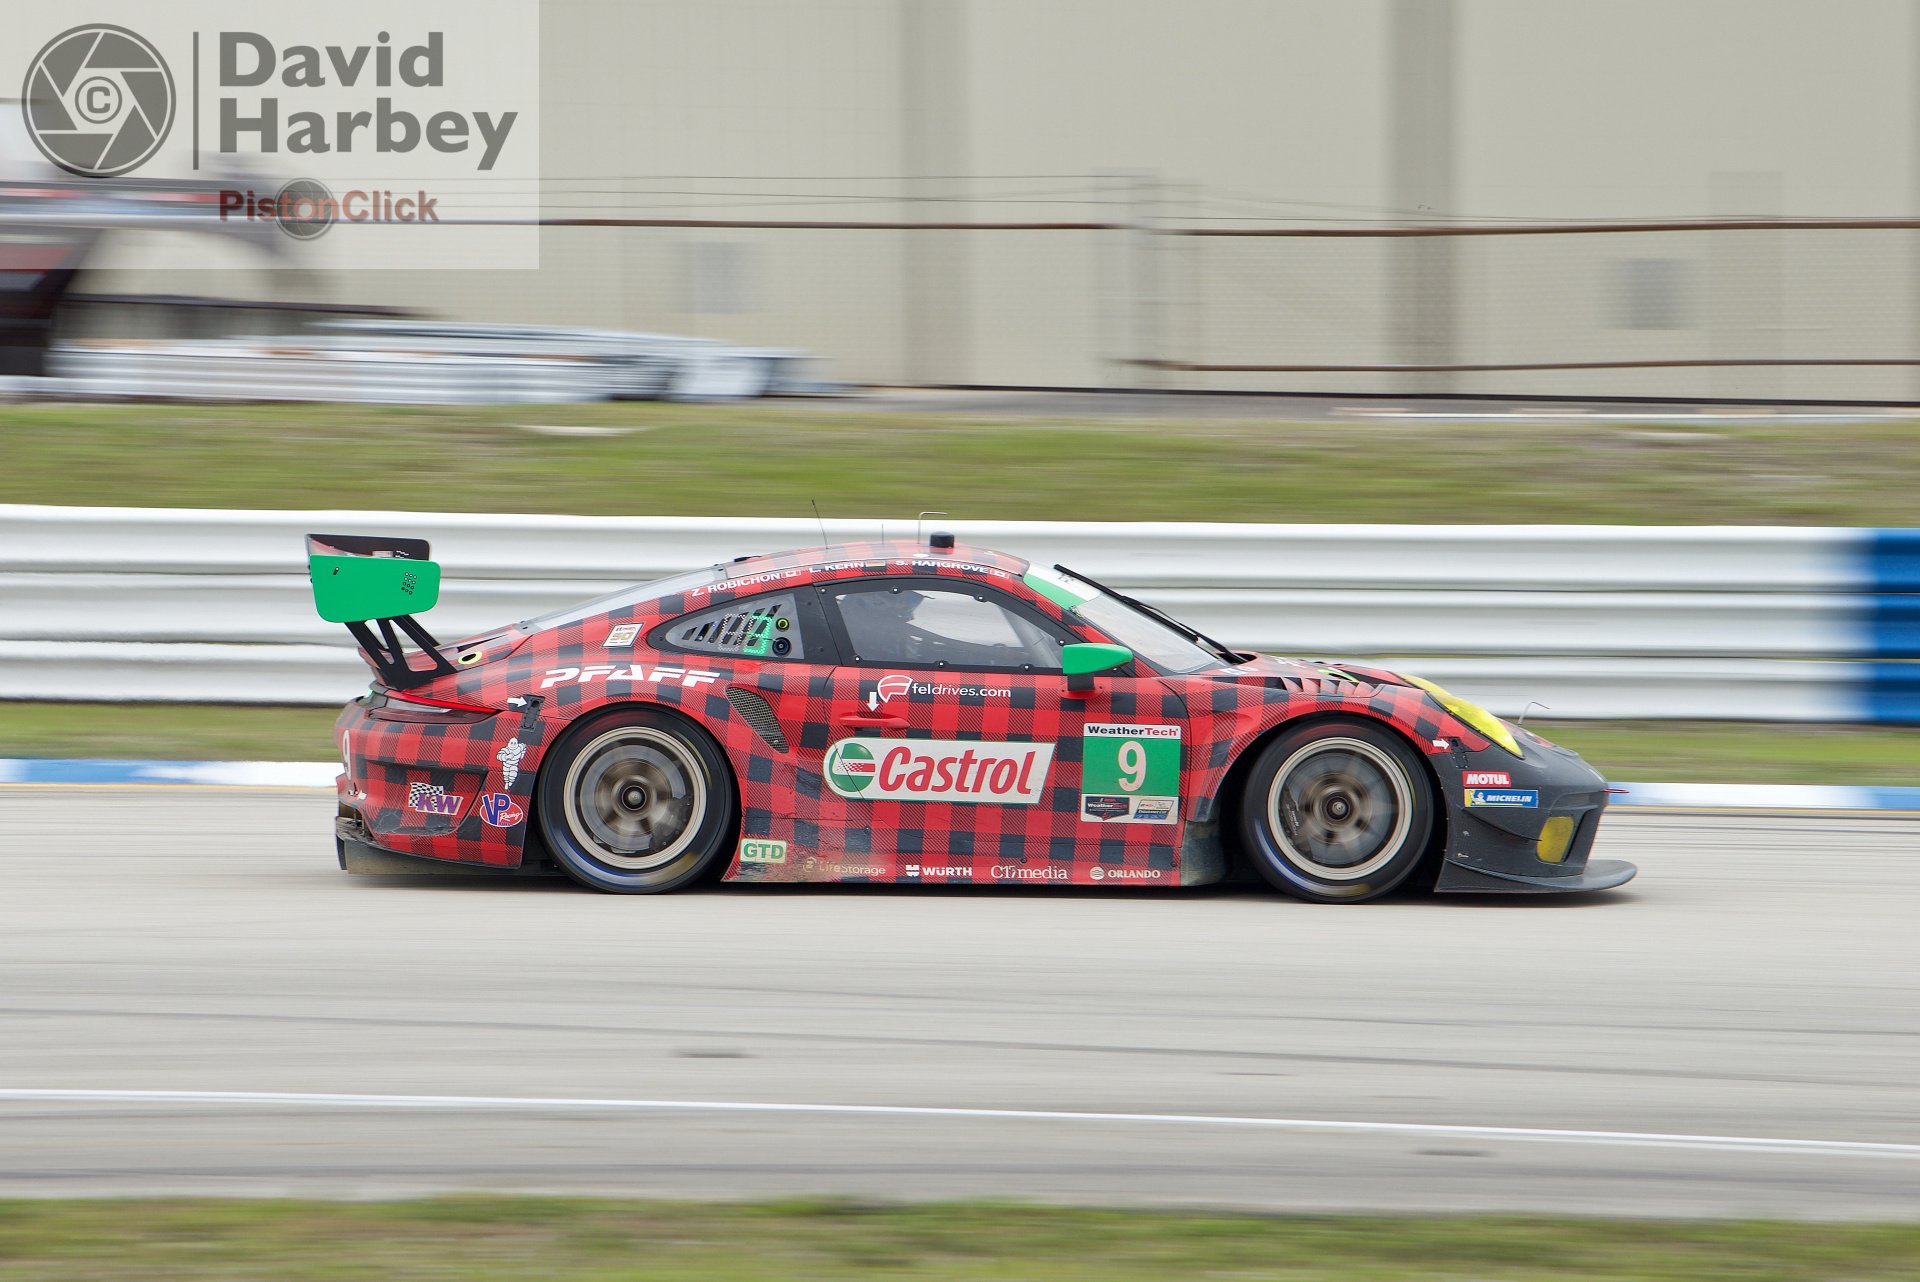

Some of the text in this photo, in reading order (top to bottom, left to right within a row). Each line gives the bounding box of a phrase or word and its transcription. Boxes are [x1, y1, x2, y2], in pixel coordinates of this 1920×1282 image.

[912, 560, 988, 573] HARGROVE
[708, 572, 780, 593] ROBICHON
[540, 664, 721, 689] PFAFF
[912, 683, 1012, 698] feldrives.com
[1087, 725, 1178, 737] WeatherTech
[879, 746, 1036, 795] Castrol
[1118, 740, 1147, 792] 9
[1466, 773, 1510, 785] MOTUL
[416, 792, 463, 815] KW
[1486, 794, 1533, 803] MICHELIN
[482, 793, 512, 826] VP
[742, 842, 785, 860] GTD
[990, 865, 1069, 880] C17media
[1107, 869, 1161, 879] ORLANDO
